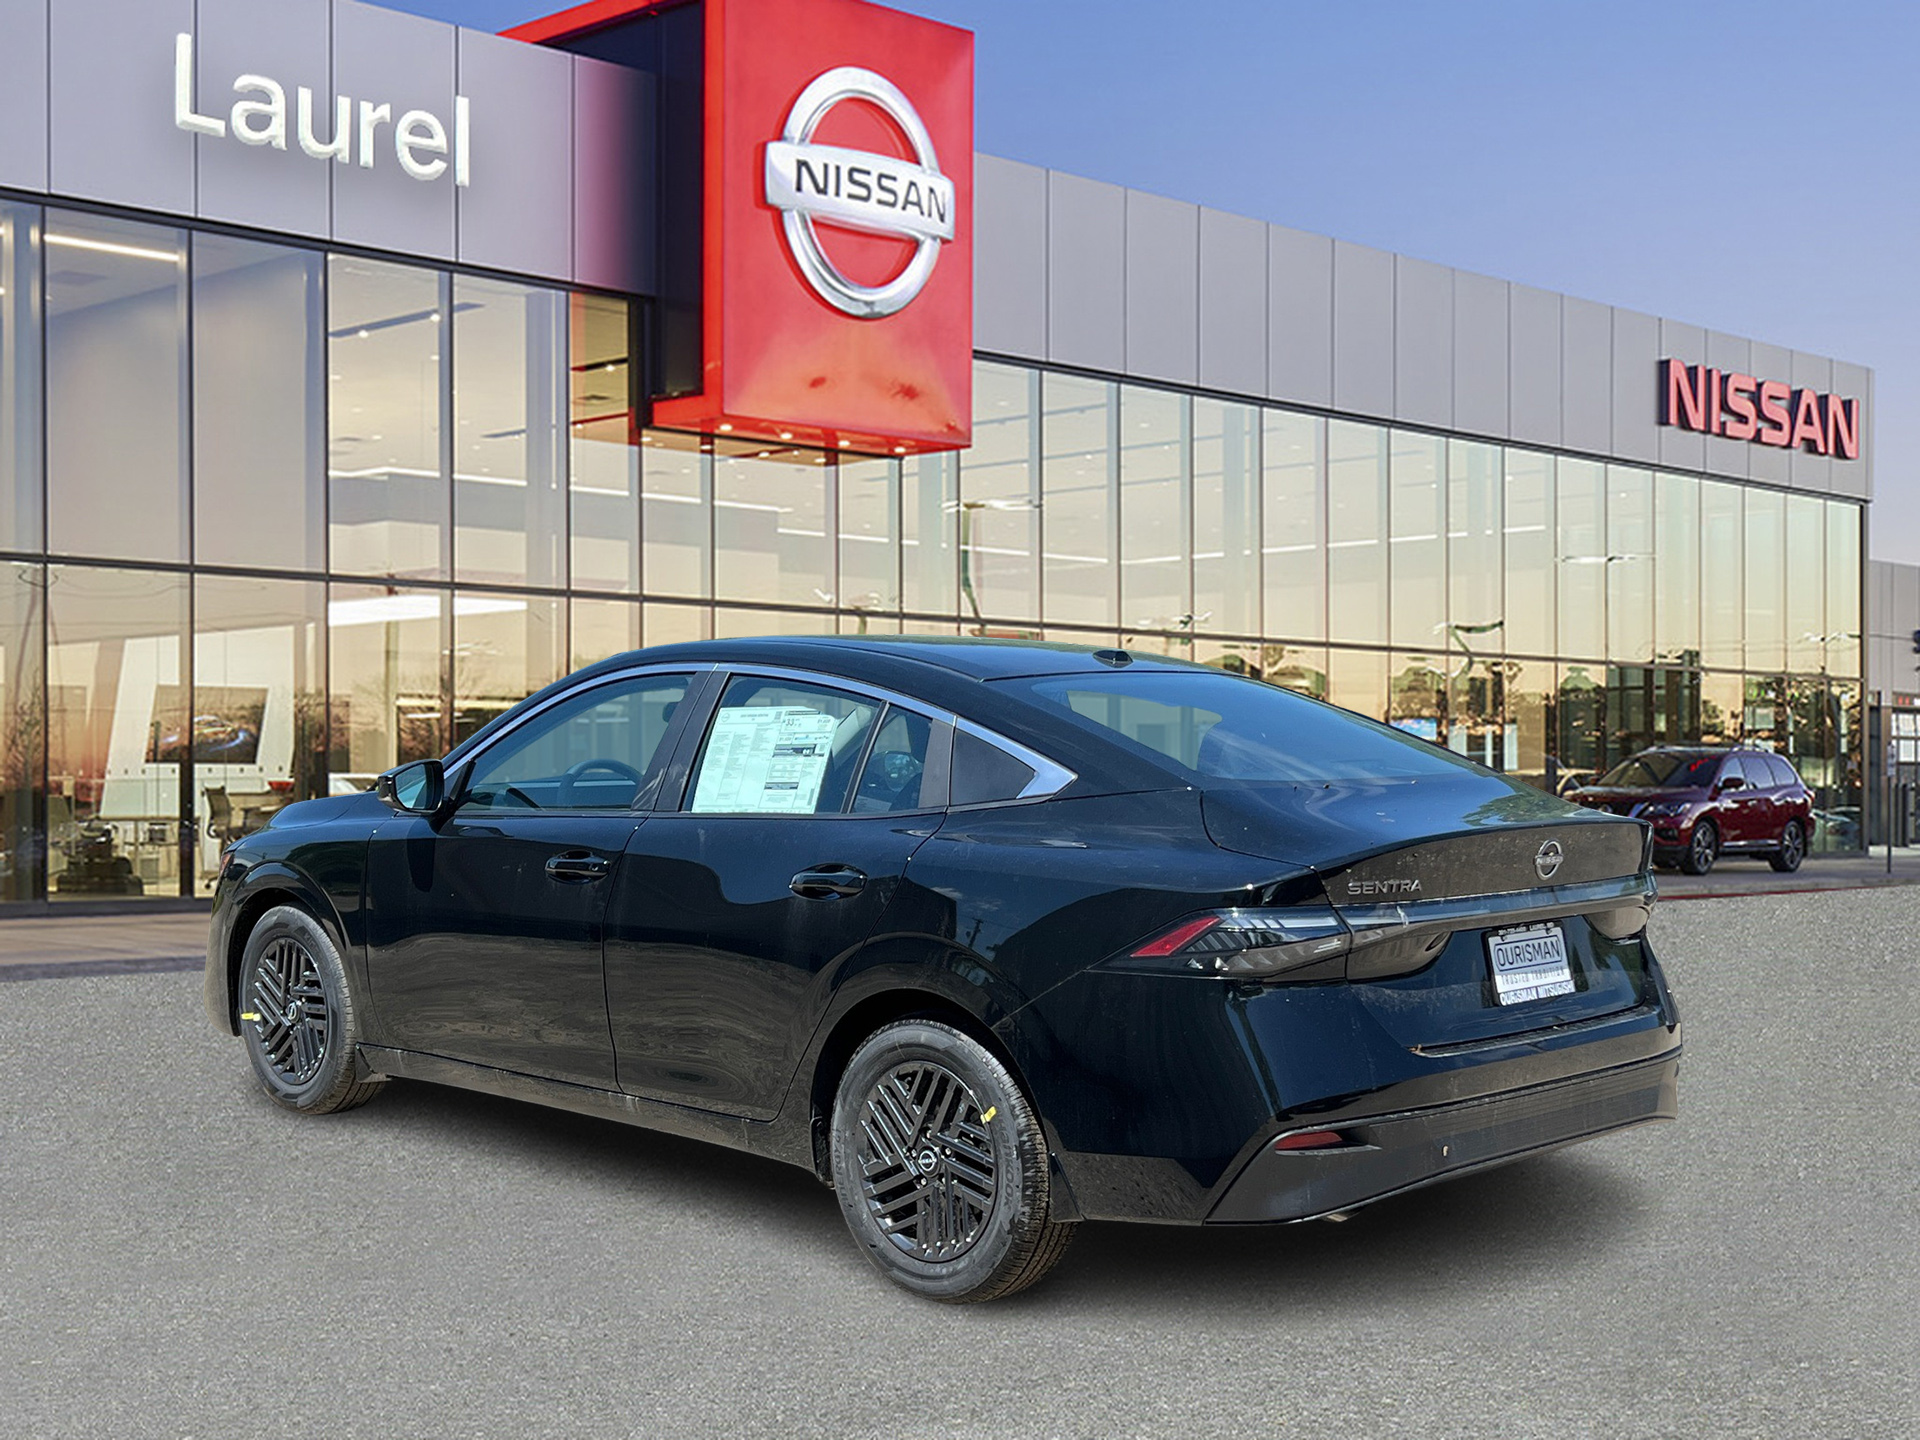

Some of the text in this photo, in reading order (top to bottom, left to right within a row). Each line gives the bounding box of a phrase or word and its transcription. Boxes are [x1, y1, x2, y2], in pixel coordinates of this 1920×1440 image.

[175, 33, 470, 188] Laurel
[794, 158, 947, 224] NISSAN
[1659, 358, 1860, 460] NISSAN
[1347, 879, 1423, 896] SENTRA
[1496, 940, 1560, 967] OURISMAN
